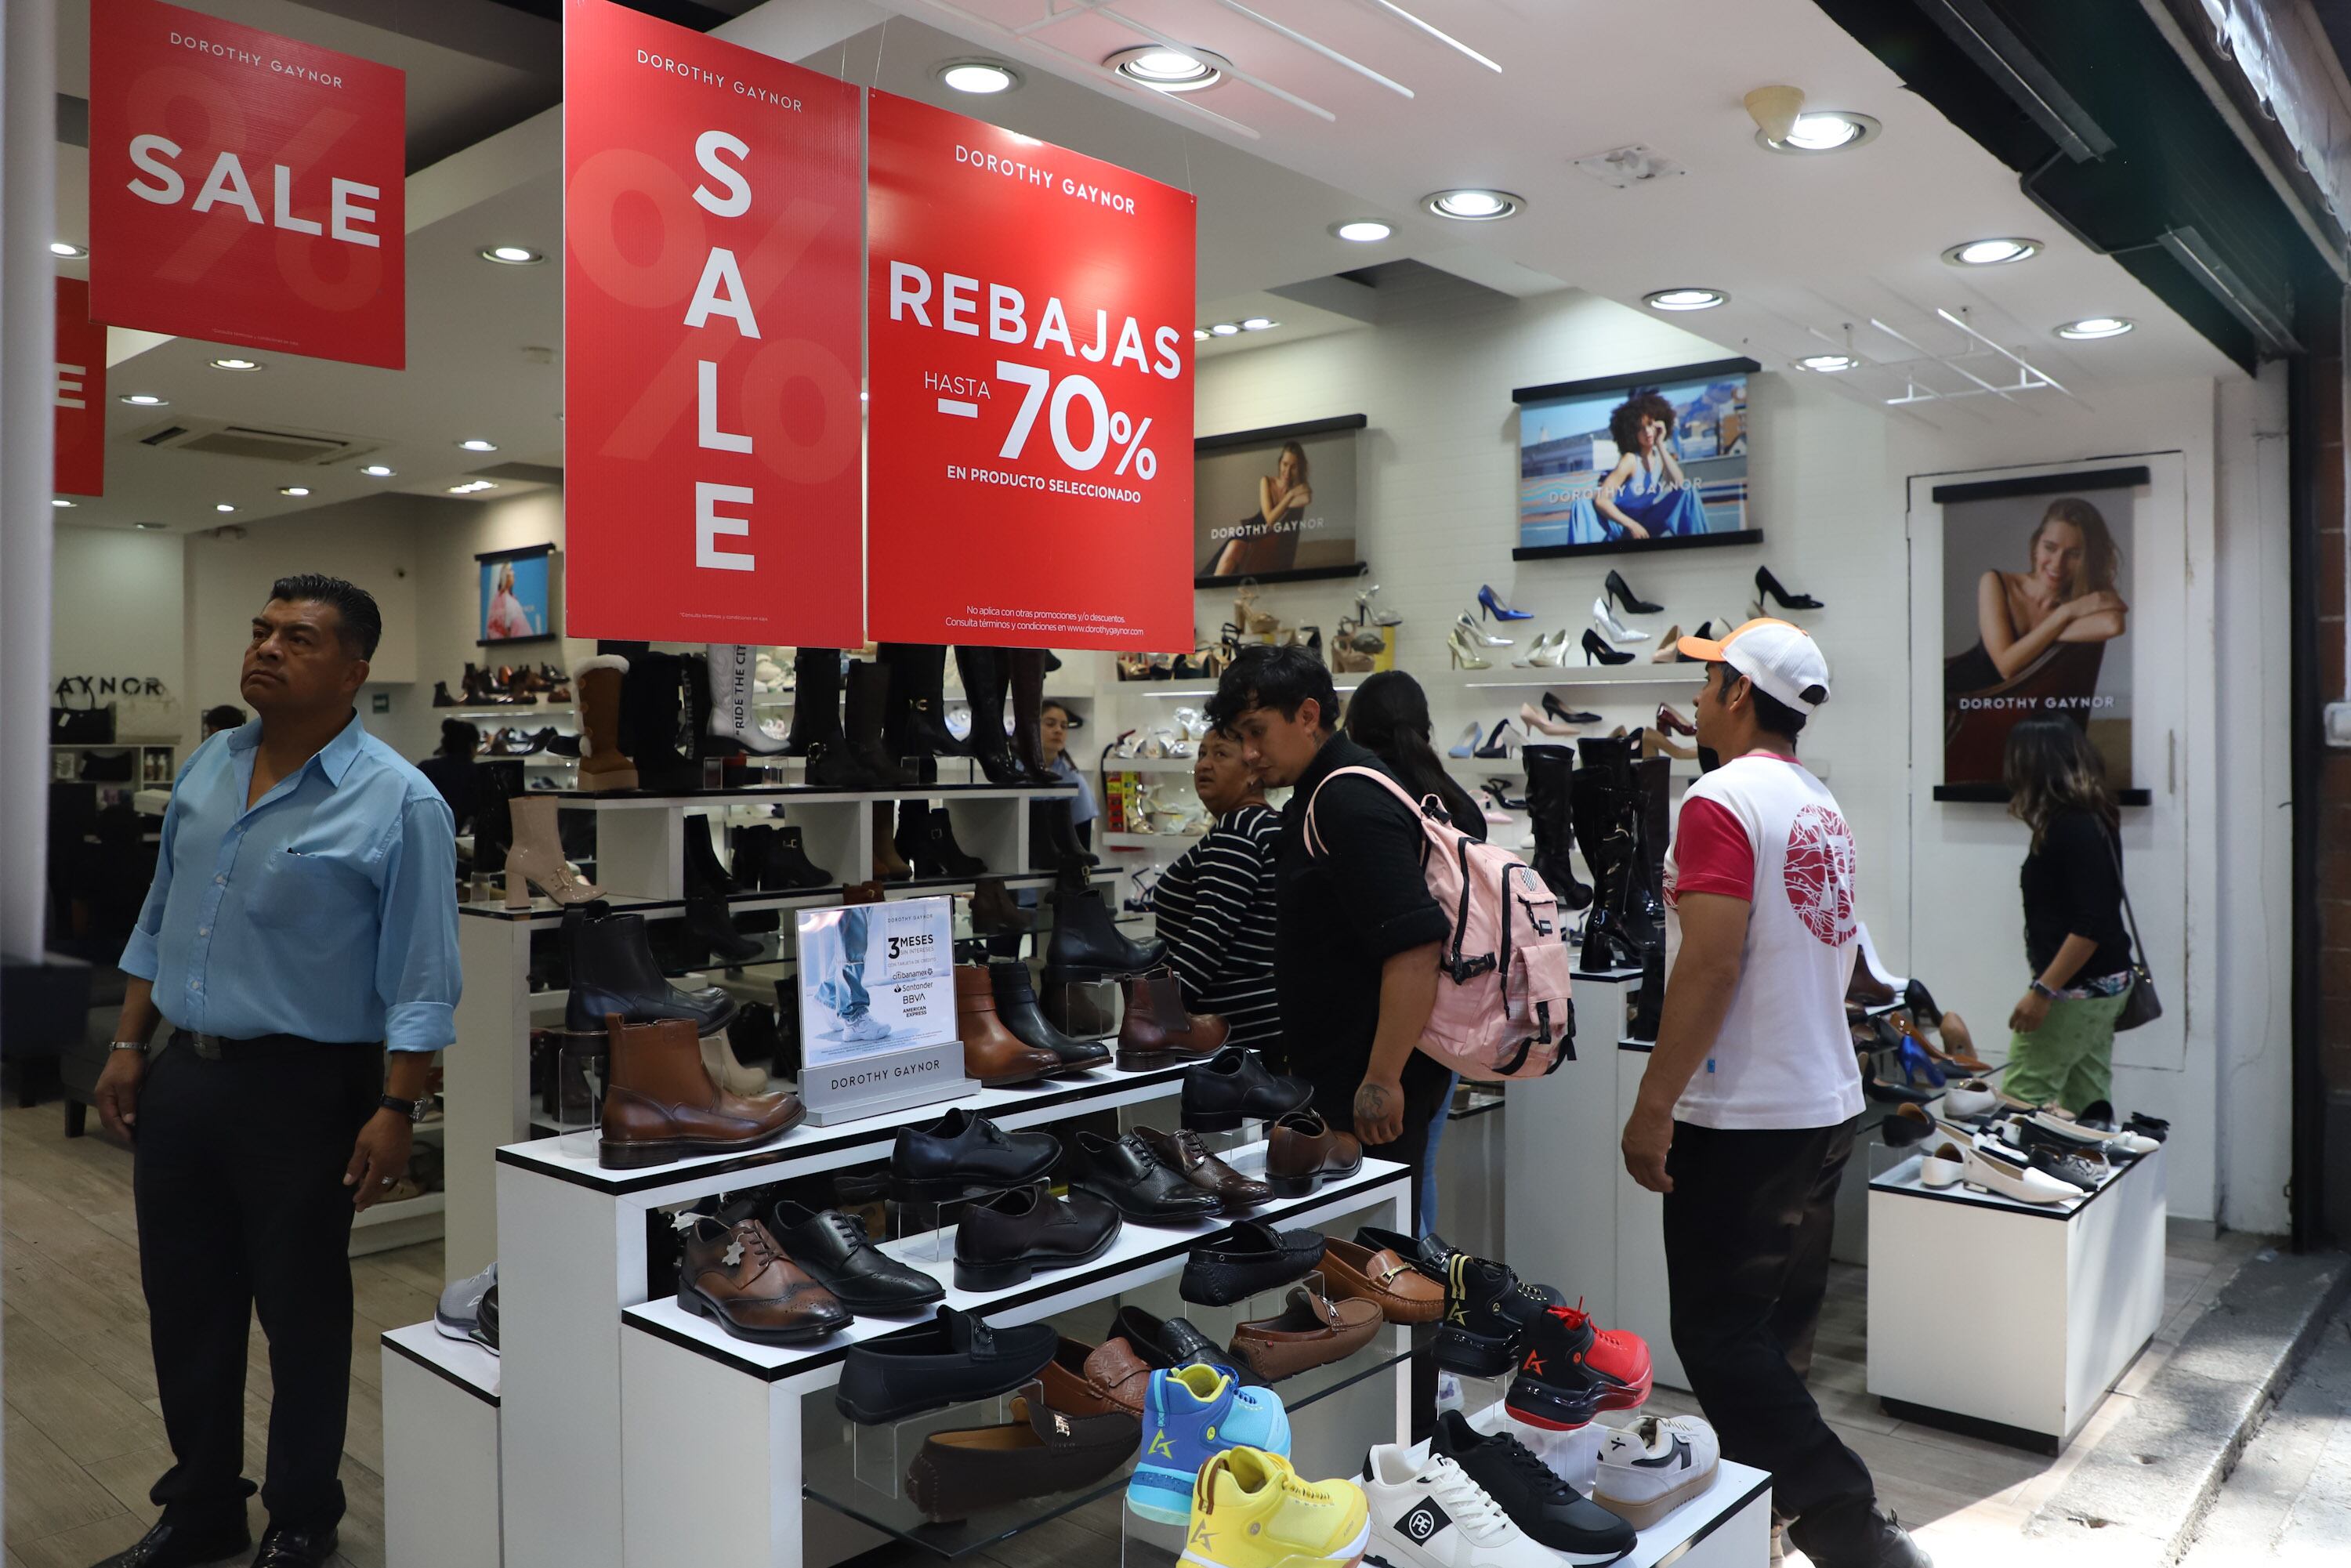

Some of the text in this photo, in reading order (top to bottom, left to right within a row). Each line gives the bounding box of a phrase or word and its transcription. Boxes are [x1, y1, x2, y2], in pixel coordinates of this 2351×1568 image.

[170, 32, 342, 89] DOROTHY GAYNOR
[637, 49, 802, 112] DOROTHY GAYNOR
[126, 134, 380, 248] SALE
[955, 145, 1136, 215] DOROTHY GAYNOR
[890, 260, 1182, 380] REBAJAS
[683, 130, 762, 572] SALE
[925, 371, 991, 400] HASTA
[947, 465, 1141, 503] EN PRODUCTO SELECCIONADO
[1549, 476, 1703, 504] DOROTHY GAYNOR
[1210, 517, 1325, 540] DOROTHY GAYNOR
[945, 617, 978, 627] Consulta
[979, 618, 1010, 629] términos
[1011, 622, 1016, 632] y
[1017, 621, 1057, 632] condiciones
[1067, 624, 1144, 636] www.dorothygaynor.com
[966, 605, 978, 615] No
[979, 607, 1000, 617] aplica
[1016, 609, 1033, 617] otras
[1034, 610, 1077, 621] promociones
[1078, 612, 1089, 621] y/o
[734, 668, 745, 695] THE
[1959, 695, 2114, 710] DOROTHY GAYNOR
[888, 934, 933, 959] 3 MESES
[893, 970, 927, 980] citibanamex
[902, 981, 933, 992] Santander
[903, 992, 926, 1005] BBVA
[831, 1059, 940, 1090] DOROTHY GAYNOR
